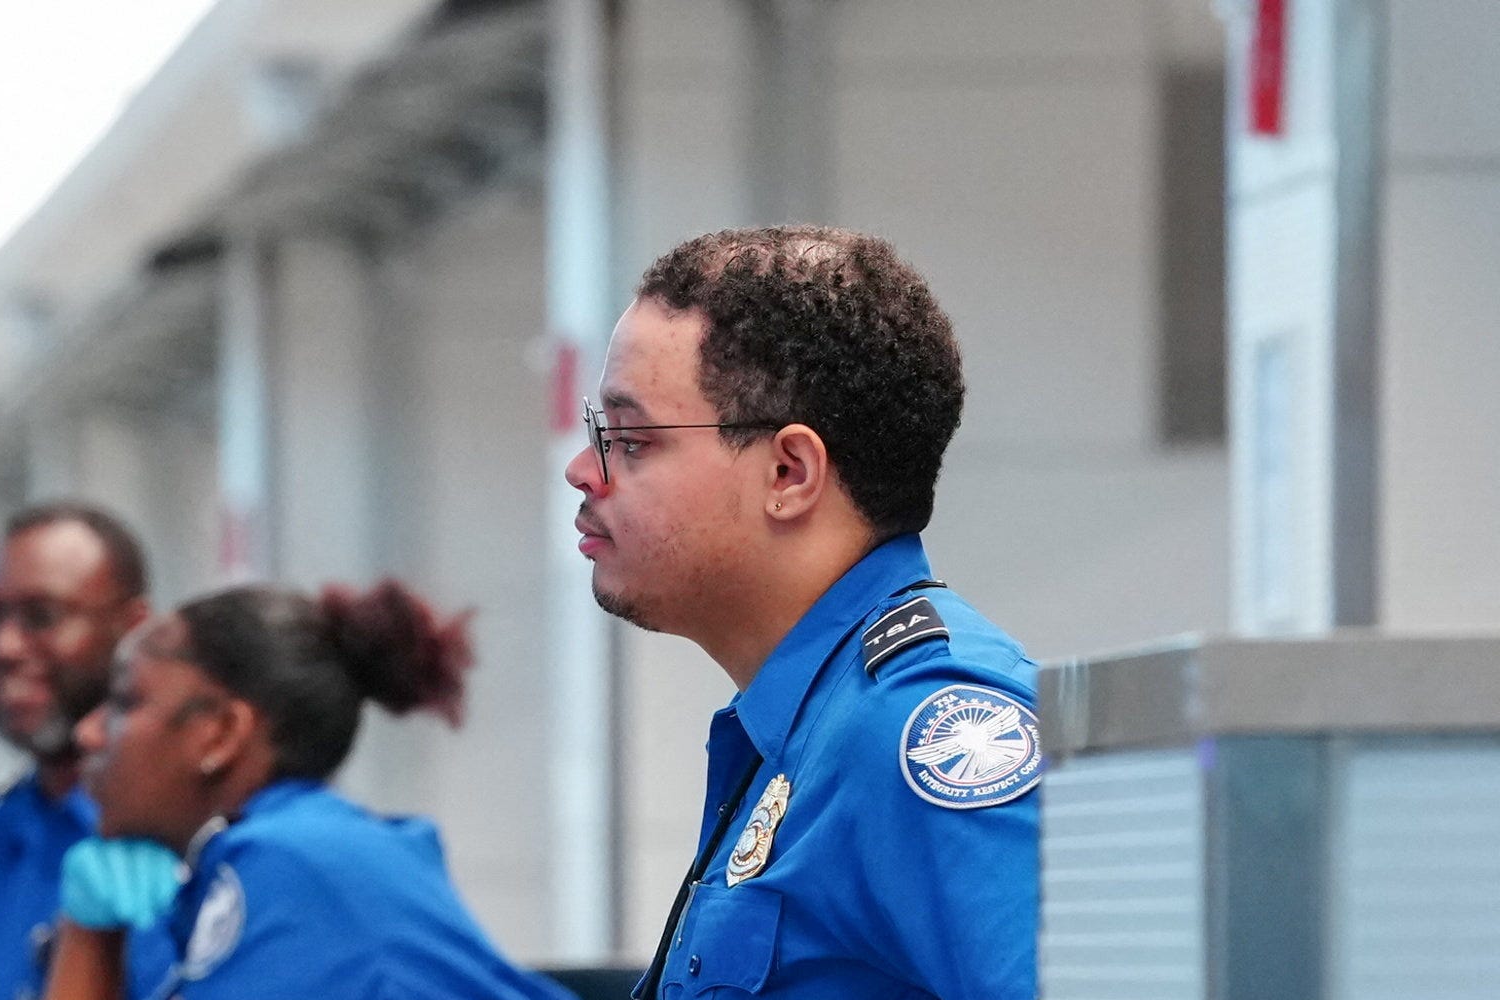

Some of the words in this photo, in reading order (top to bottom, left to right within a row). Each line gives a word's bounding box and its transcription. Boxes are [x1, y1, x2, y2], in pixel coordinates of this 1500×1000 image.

[865, 614, 929, 646] TSA
[933, 693, 959, 708] TSA
[919, 769, 970, 797] INTEGRITY
[973, 774, 1021, 796] RESPECT
